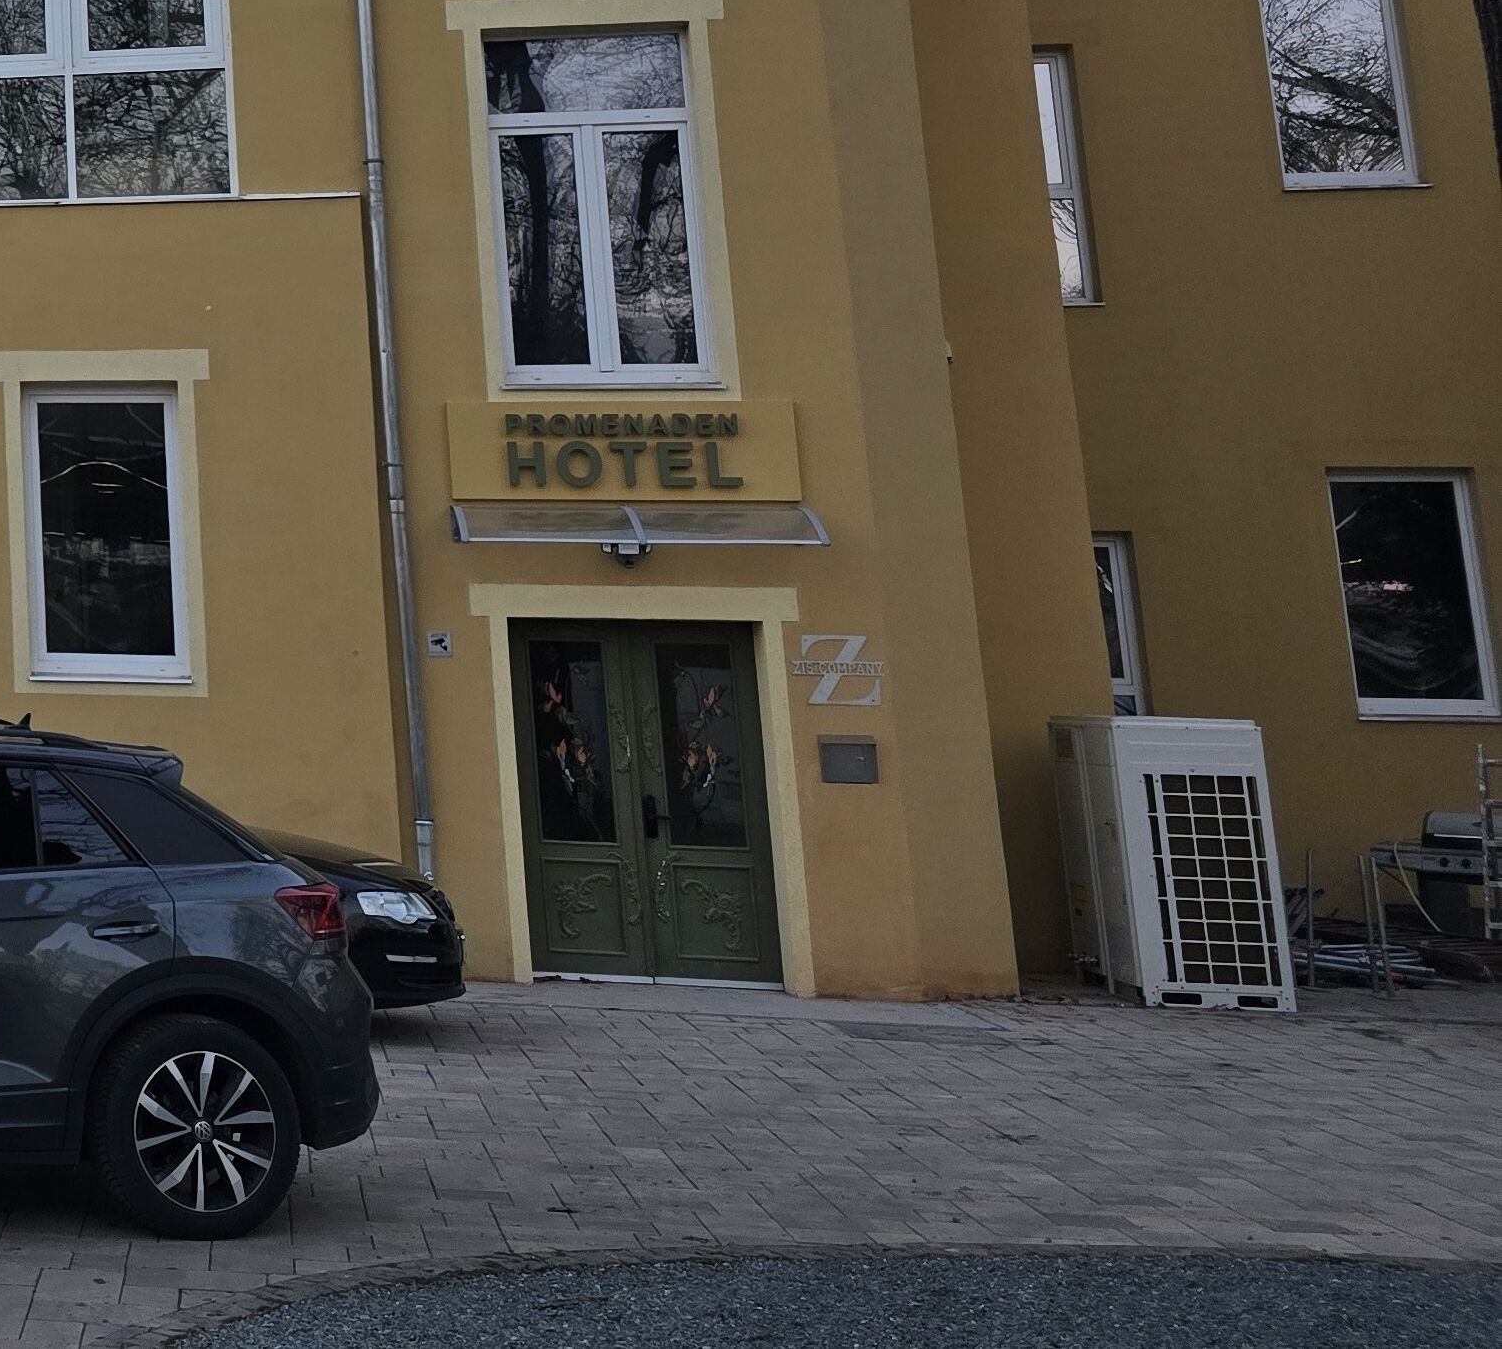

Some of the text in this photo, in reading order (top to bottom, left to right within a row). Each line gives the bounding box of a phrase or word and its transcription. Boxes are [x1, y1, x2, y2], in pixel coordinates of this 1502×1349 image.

[505, 413, 739, 436] PROMENADEN
[506, 440, 744, 488] HOTEL
[817, 661, 884, 676] COMPANY
